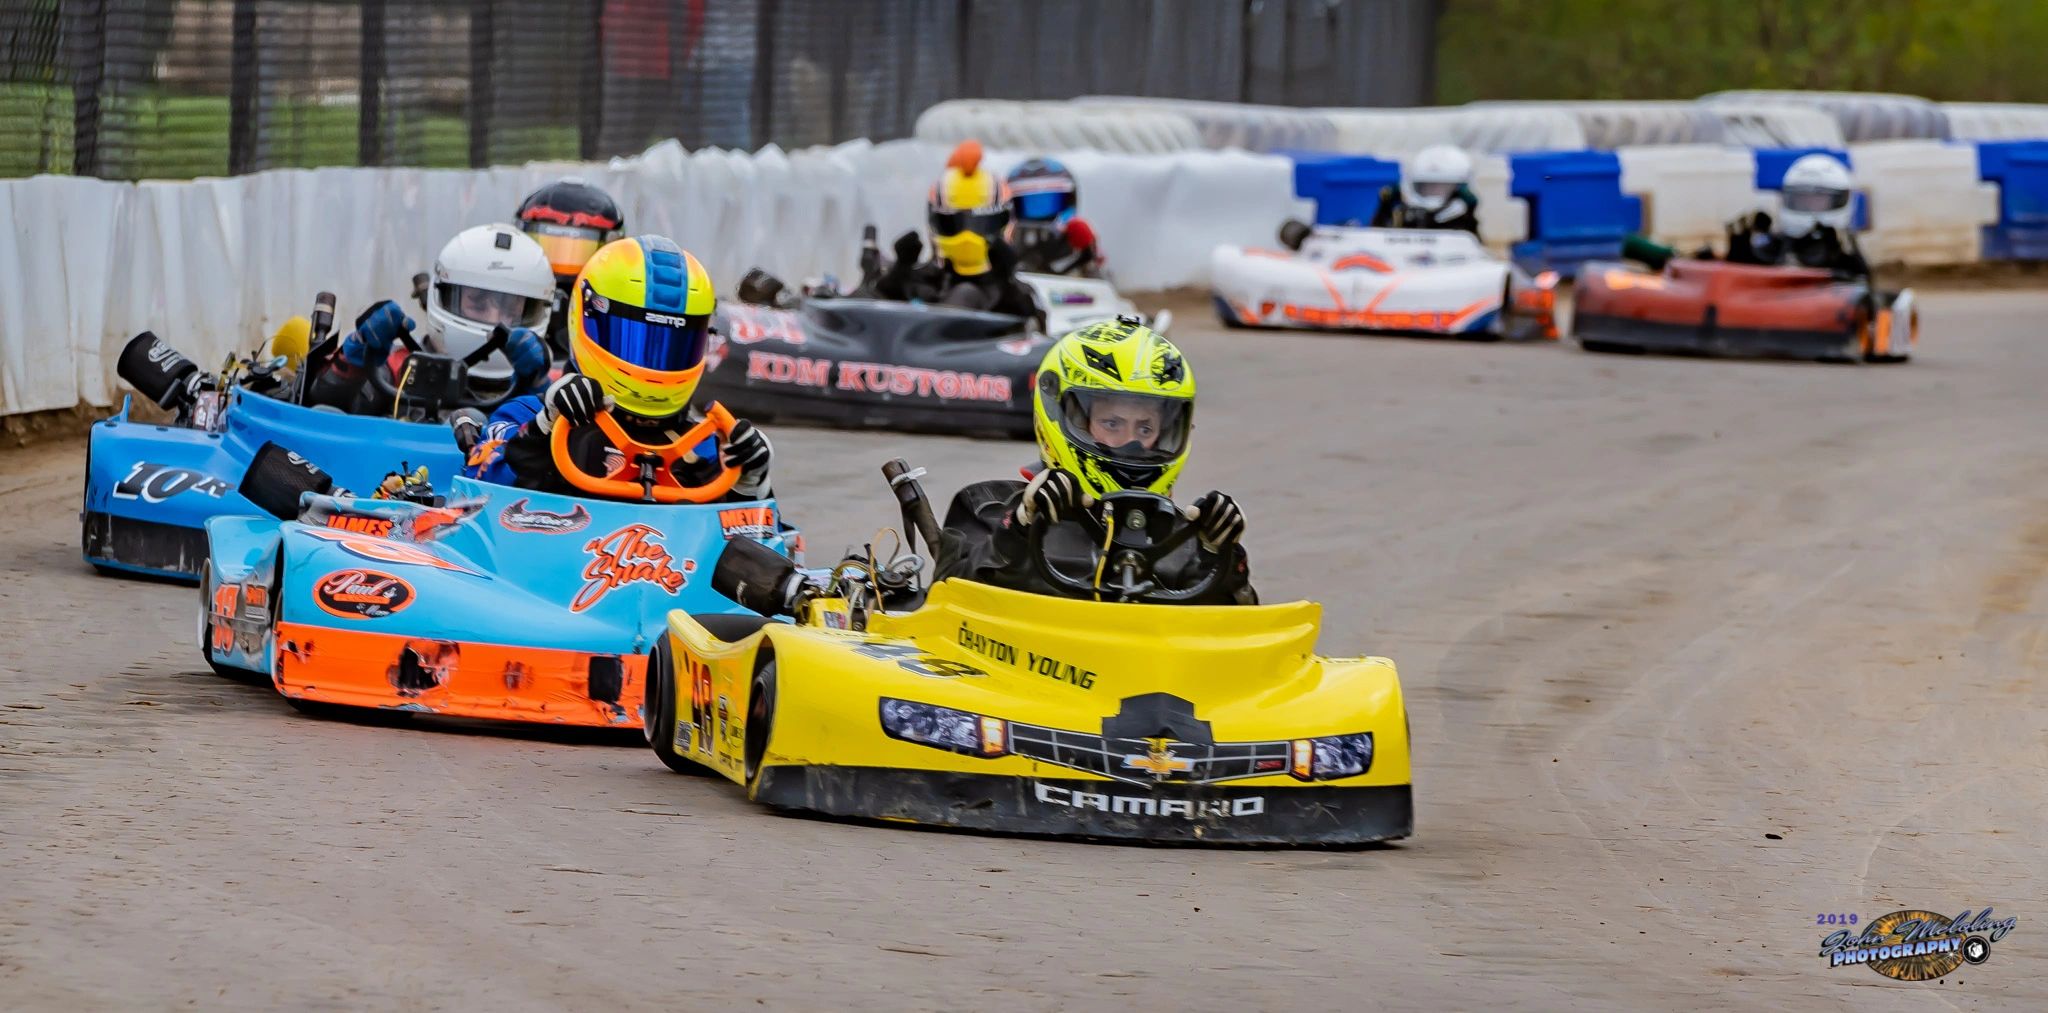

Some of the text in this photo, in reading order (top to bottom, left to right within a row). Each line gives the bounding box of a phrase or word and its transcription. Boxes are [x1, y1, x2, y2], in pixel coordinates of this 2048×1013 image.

[645, 312, 686, 328] zamp
[748, 351, 1012, 402] KDM KUSTOMS
[1027, 651, 1098, 691] YOUNG
